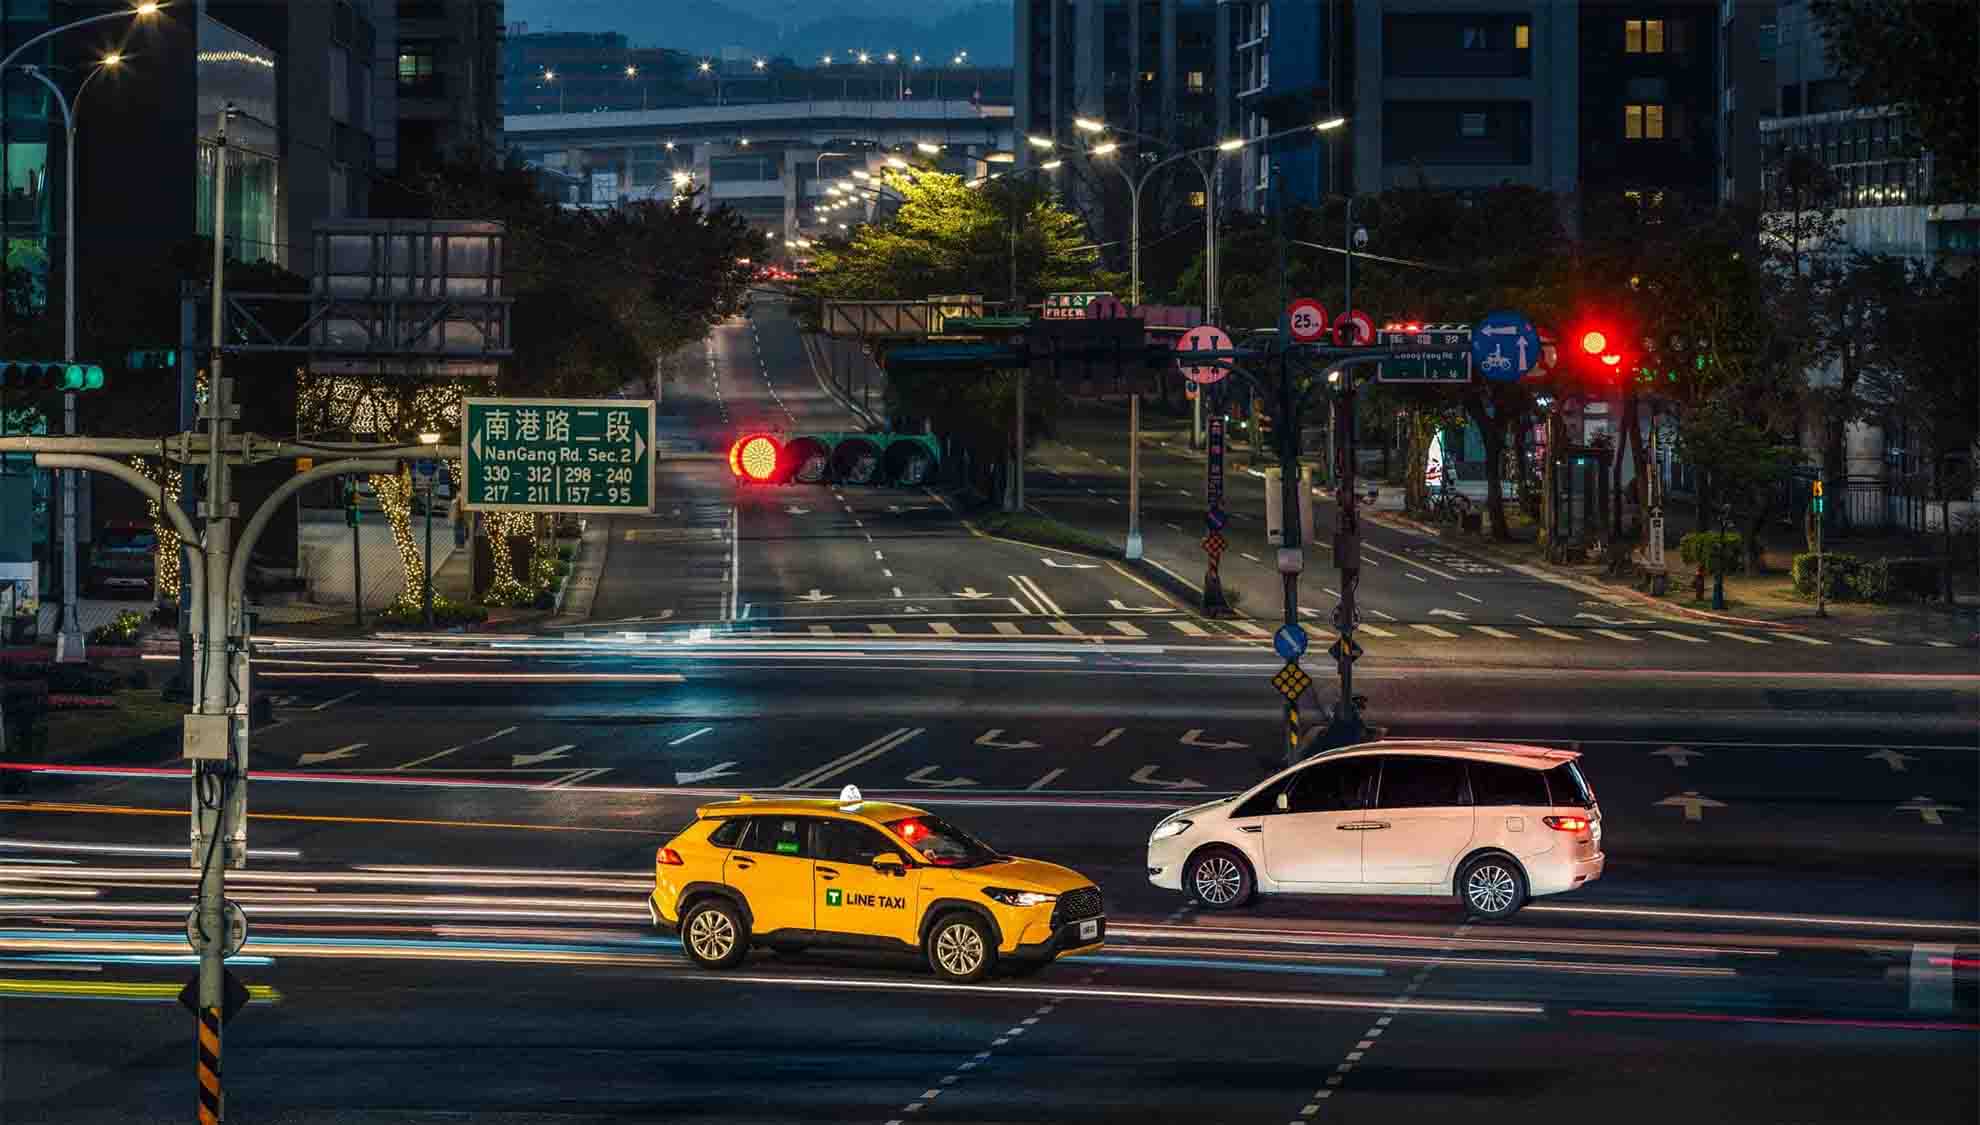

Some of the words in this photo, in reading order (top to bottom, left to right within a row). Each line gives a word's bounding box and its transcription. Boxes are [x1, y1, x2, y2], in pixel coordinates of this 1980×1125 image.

[1295, 314, 1311, 328] 25
[484, 409, 632, 443] 南港路二段
[485, 447, 556, 464] NanGang
[560, 448, 583, 462] Rd.
[588, 448, 618, 462] Sec.
[621, 448, 632, 463] 2
[483, 466, 510, 482] 330
[527, 466, 552, 482] 312
[564, 467, 592, 483] 298
[607, 468, 632, 484] 240
[484, 485, 509, 501] 217
[527, 486, 550, 502] 211
[567, 486, 590, 503] 157
[608, 487, 632, 503] 95
[846, 893, 876, 907] LINE
[878, 896, 905, 909] TAXI
